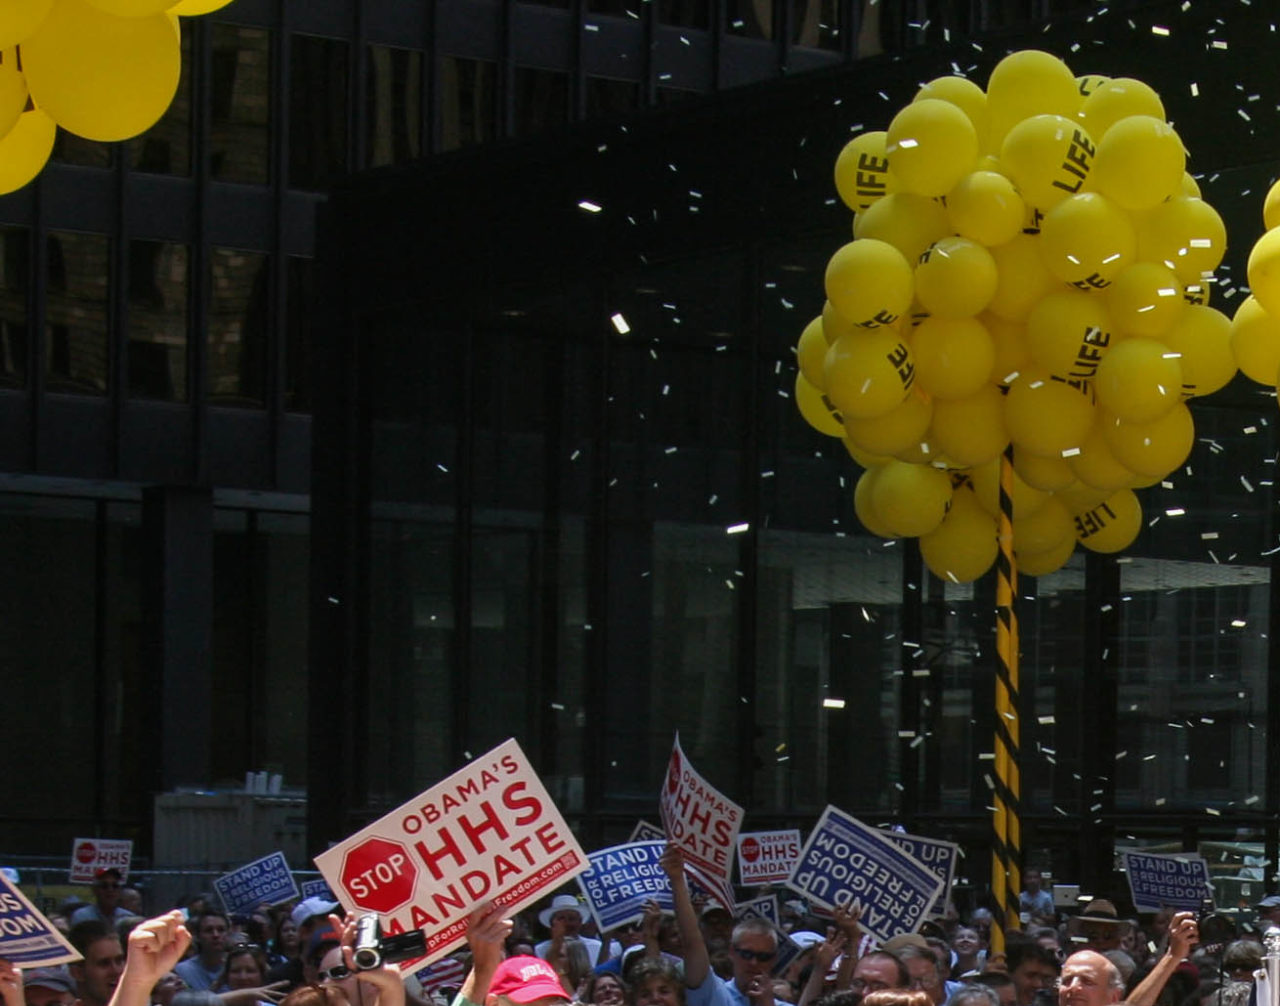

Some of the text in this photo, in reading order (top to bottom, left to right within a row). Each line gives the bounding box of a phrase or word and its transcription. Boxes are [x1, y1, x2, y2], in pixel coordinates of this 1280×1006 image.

[1053, 130, 1096, 193] LIFE
[1069, 327, 1110, 377] LIFE
[887, 343, 915, 395] IFE
[1075, 503, 1117, 539] LIFE
[402, 755, 519, 835] OBAMA'S
[415, 781, 543, 881] HHS
[675, 784, 732, 847] HHS
[742, 861, 797, 876] MANDAT
[762, 843, 798, 862] HHS
[816, 832, 914, 904] FREEDOM
[921, 845, 950, 863] UP
[1129, 856, 1202, 875] STAND UP
[219, 857, 281, 892] STAND UP
[350, 853, 408, 899] STOP
[382, 822, 566, 937] MANDATE
[600, 864, 665, 888] RELIGIO
[608, 878, 672, 902] FREEDO
[797, 870, 830, 897] UP
[808, 850, 905, 919] RELIGIOUS
[1140, 871, 1205, 888] RELIGIOUS
[1142, 883, 1212, 898] FREEDOM
[235, 877, 290, 906] FREEDOM
[587, 879, 607, 908] FOR
[903, 895, 926, 927] FOR
